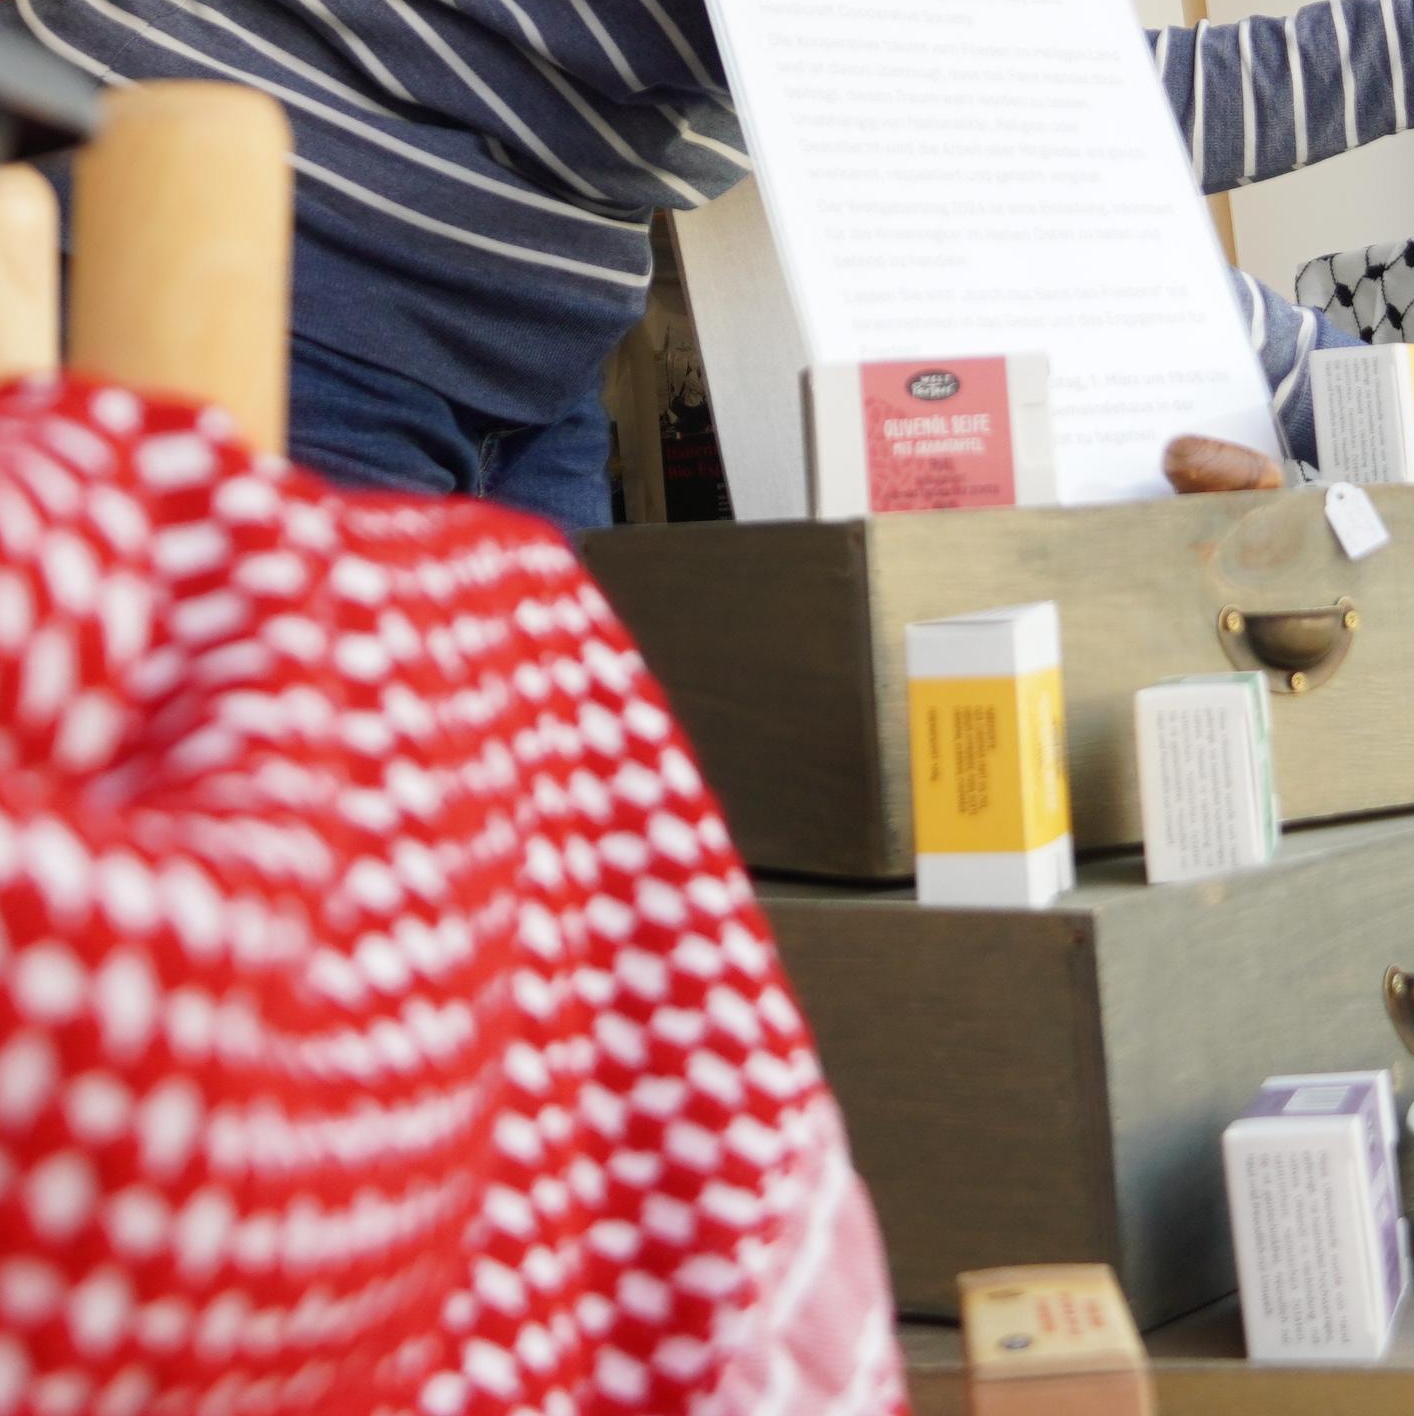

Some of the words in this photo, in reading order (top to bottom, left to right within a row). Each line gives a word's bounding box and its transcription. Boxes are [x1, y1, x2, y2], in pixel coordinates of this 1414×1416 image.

[883, 414, 948, 439] OLIVENÖL
[951, 413, 992, 434] SEIFE
[893, 440, 913, 455] MIT
